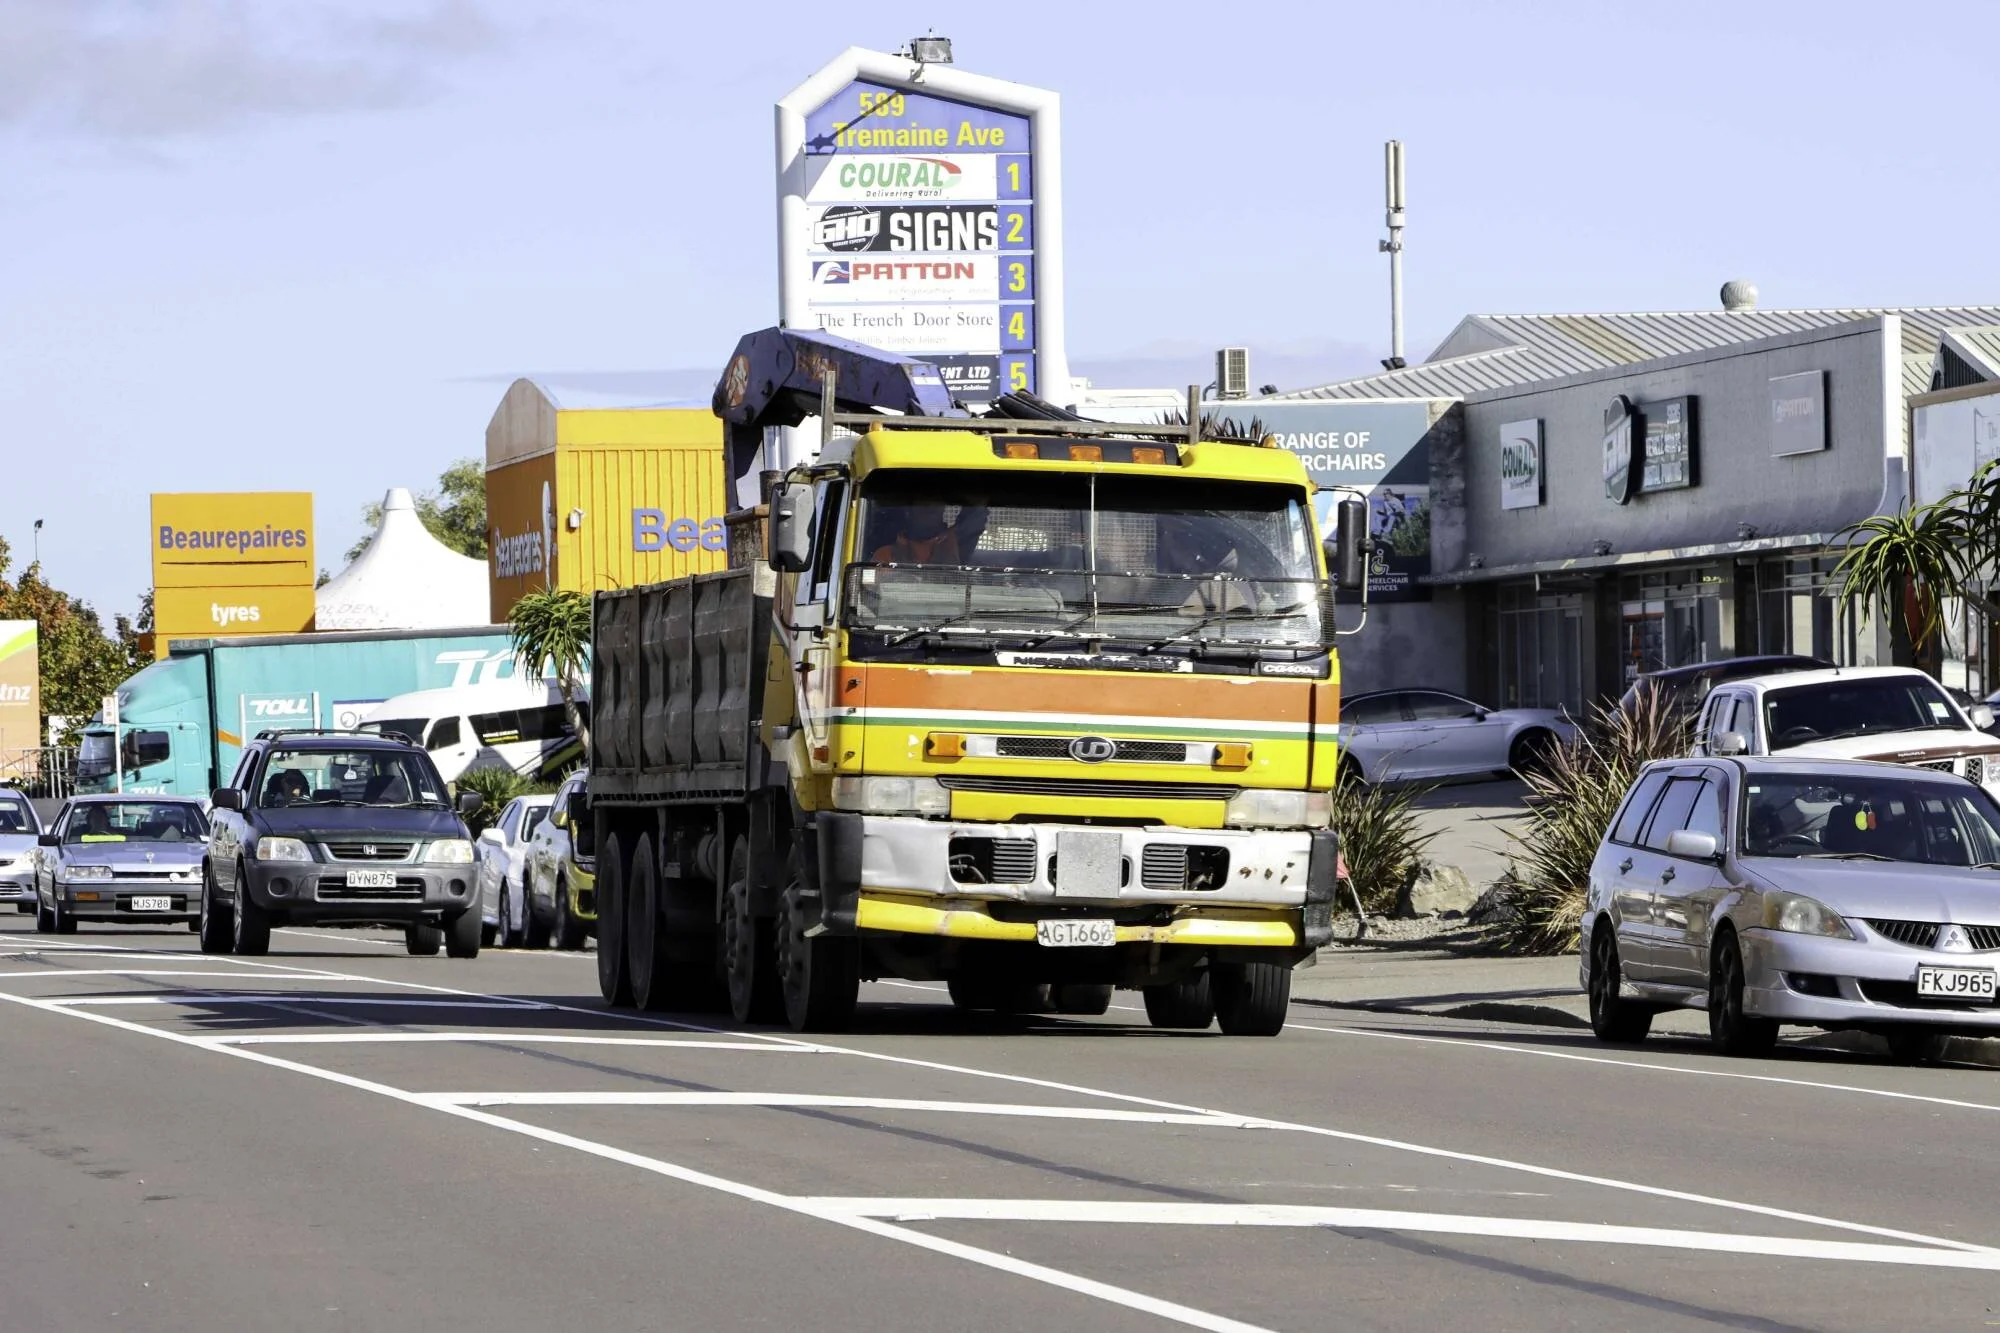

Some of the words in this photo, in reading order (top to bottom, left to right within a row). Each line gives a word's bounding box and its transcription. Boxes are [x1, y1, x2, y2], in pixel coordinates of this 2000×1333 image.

[859, 92, 905, 117] 589
[832, 122, 948, 147] Tremaine
[956, 122, 1004, 146] Ave
[839, 162, 944, 188] COURAL
[1007, 163, 1019, 191] 1
[866, 190, 913, 198] Delivering
[918, 189, 942, 197] Rural
[890, 211, 998, 252] SIGNS
[1006, 213, 1024, 242] 2
[852, 262, 975, 280] PATTON
[1008, 263, 1025, 292] 3
[815, 313, 845, 327] The
[853, 312, 903, 327] French
[914, 312, 950, 326] Door
[957, 312, 994, 326] Store
[1008, 312, 1025, 340] 4
[968, 366, 990, 379] LTD
[1009, 362, 1026, 391] 5
[1273, 431, 1340, 449] RANGE
[1344, 431, 1370, 449] OF
[160, 525, 307, 553] Beaurepaires
[1367, 576, 1408, 584] HEELCHAIR
[211, 603, 260, 625] tyres
[249, 698, 309, 716] TOLL
[1074, 742, 1111, 758] UD
[1921, 972, 1993, 994] FKJ965
